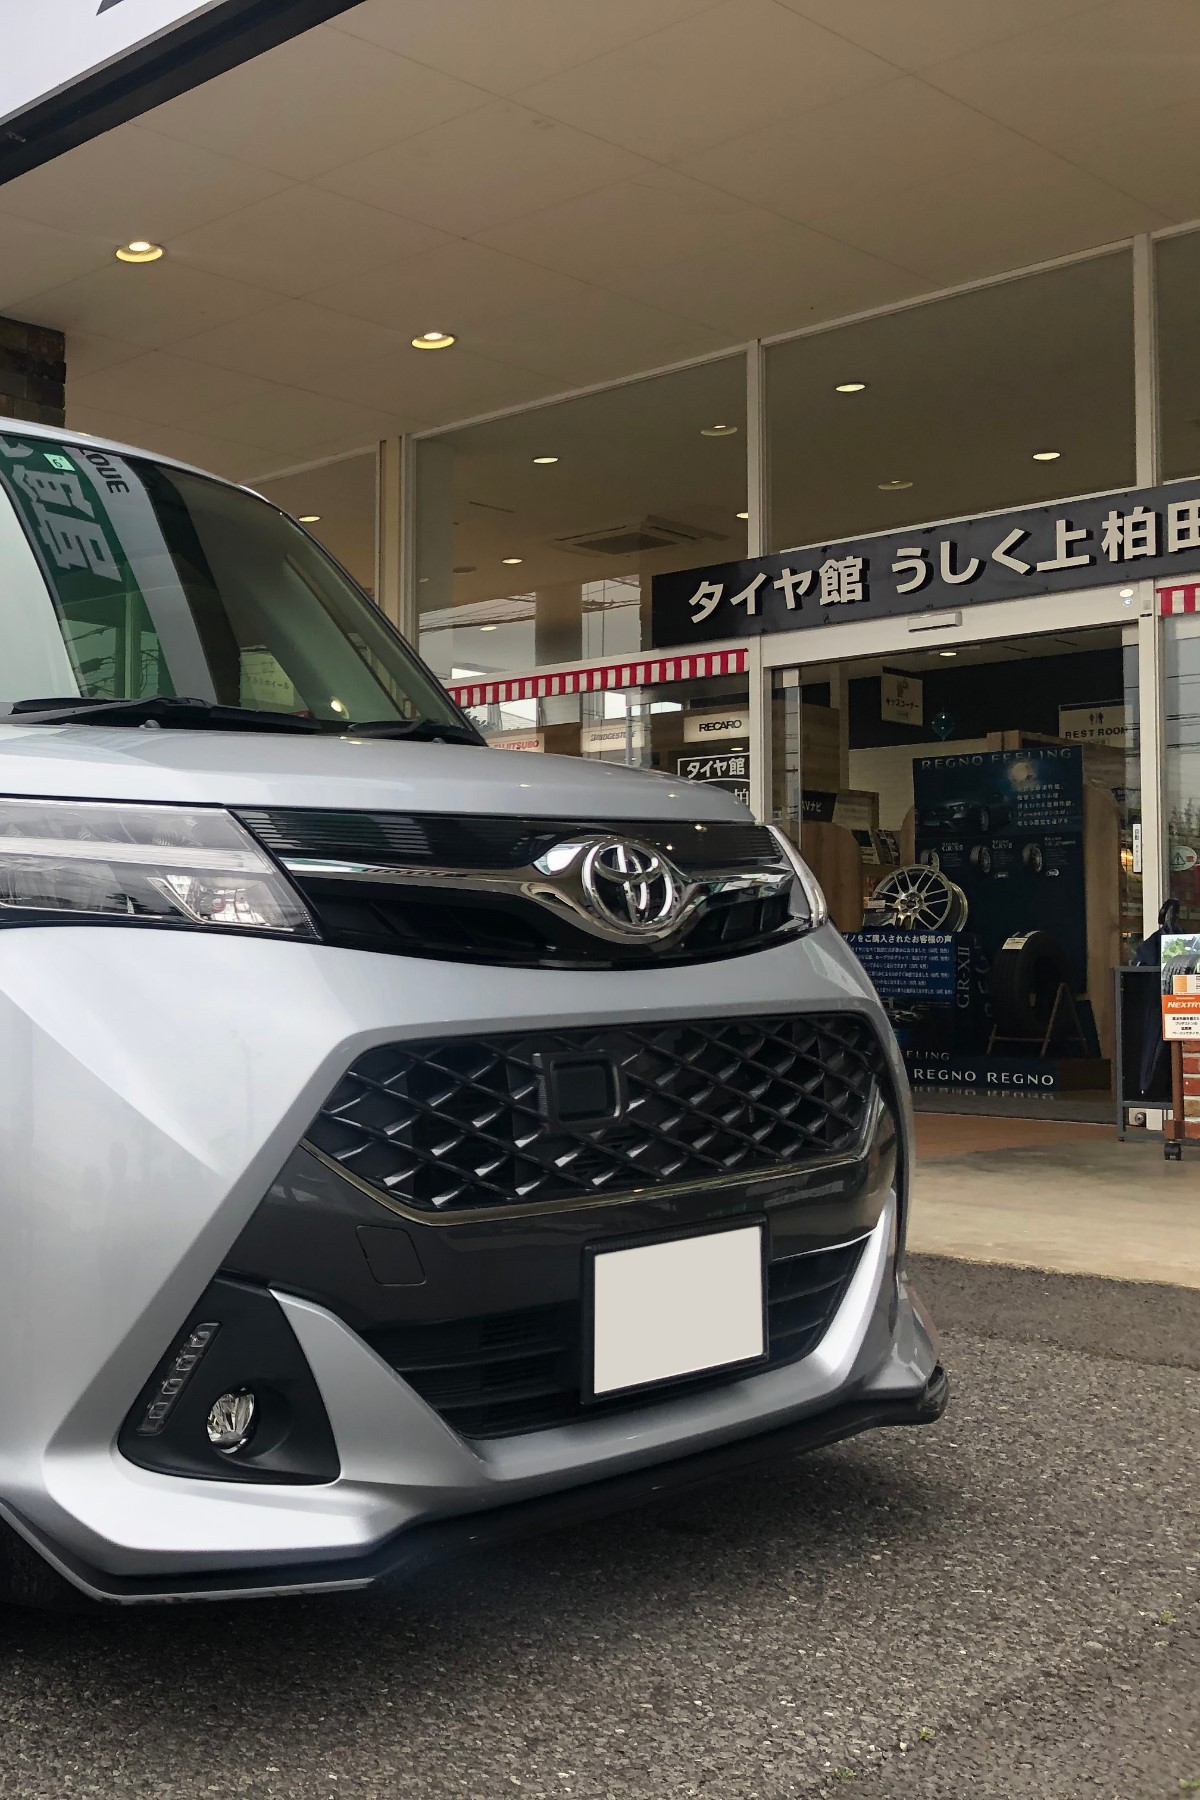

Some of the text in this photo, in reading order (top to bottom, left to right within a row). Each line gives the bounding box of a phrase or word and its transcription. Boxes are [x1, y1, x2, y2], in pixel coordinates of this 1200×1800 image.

[688, 498, 1200, 624] タイヤ館 うしく上柏田
[699, 719, 742, 732] RECARO
[590, 730, 636, 742] BRIDGESTE
[1065, 729, 1095, 739] REST
[687, 757, 745, 778] タイヤ館
[921, 755, 983, 770] REGNO
[914, 1068, 1054, 1086] REGNO REGNO
